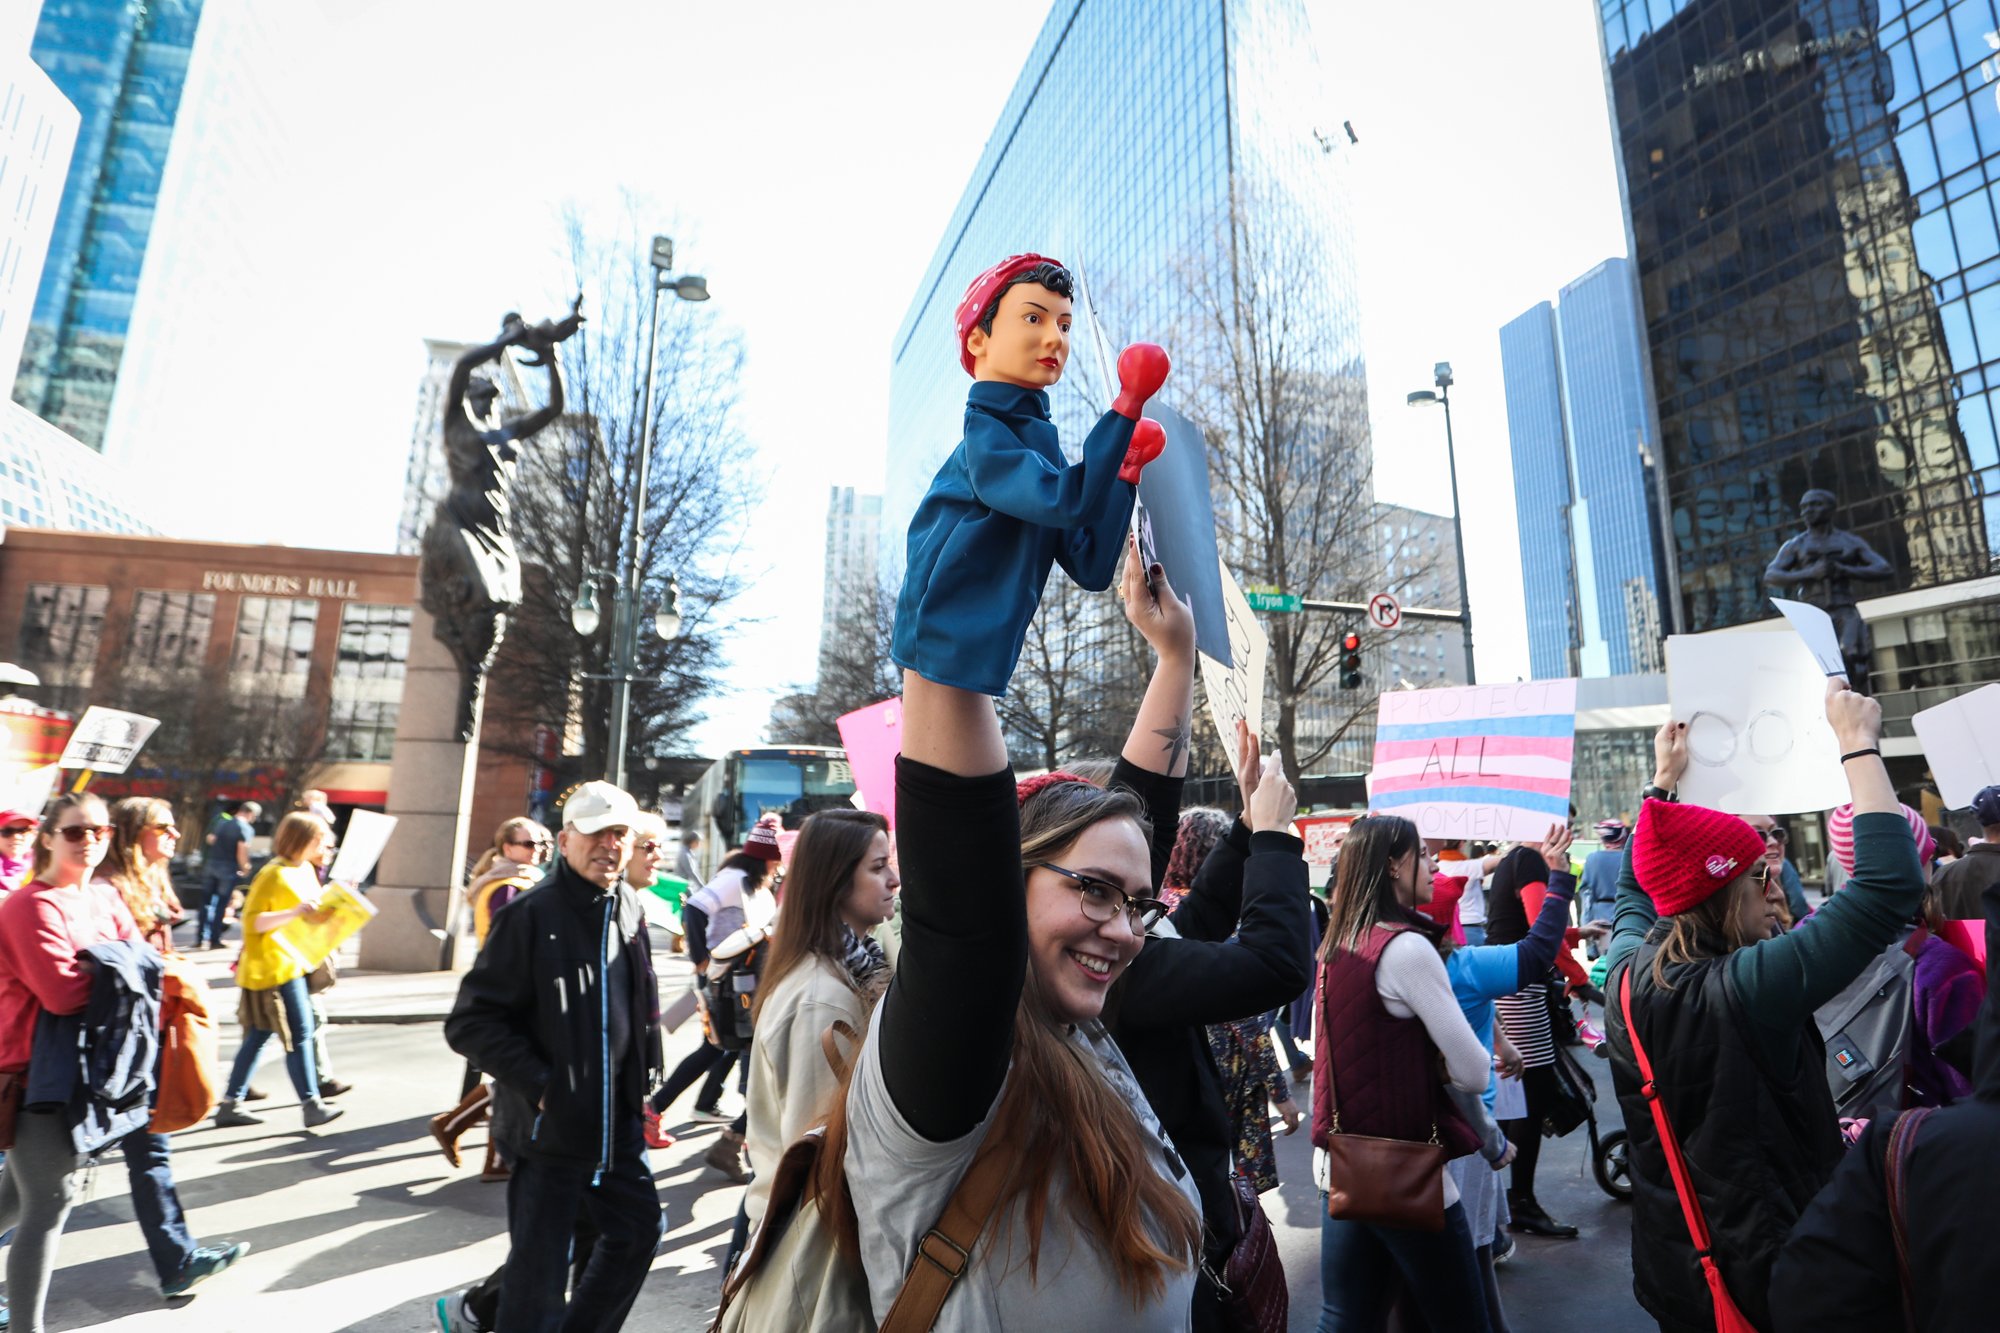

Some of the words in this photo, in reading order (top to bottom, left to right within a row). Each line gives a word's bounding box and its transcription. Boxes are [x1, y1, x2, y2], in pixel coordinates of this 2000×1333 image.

[202, 570, 302, 595] FOUNDERS
[308, 577, 359, 599] HALL
[1256, 594, 1283, 610] Tryon
[1390, 682, 1561, 722] PROTECT
[1420, 736, 1502, 782] ALL
